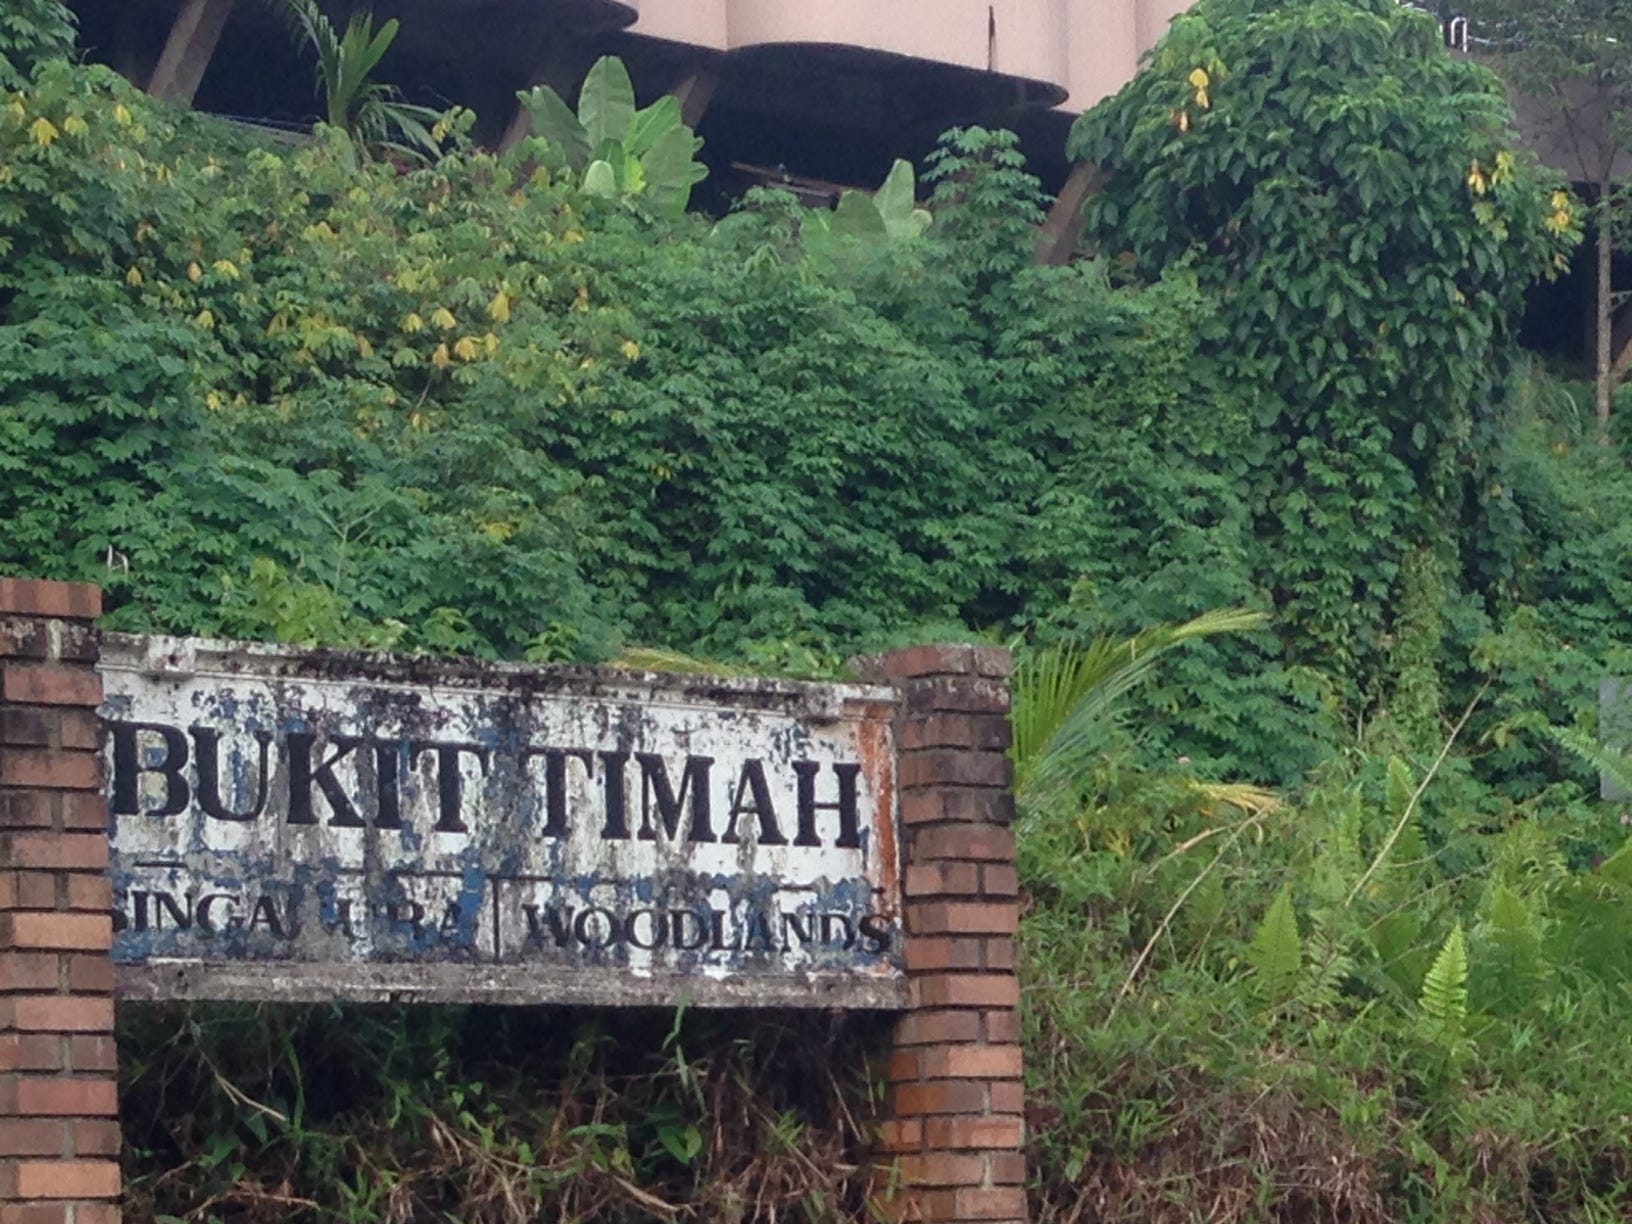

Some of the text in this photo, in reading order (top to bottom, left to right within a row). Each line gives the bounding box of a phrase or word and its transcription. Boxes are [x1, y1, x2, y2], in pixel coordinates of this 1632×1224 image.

[103, 720, 863, 848] BUKIT TIMAH
[112, 889, 468, 945] INGAURA
[522, 902, 895, 953] WOODLANDS
